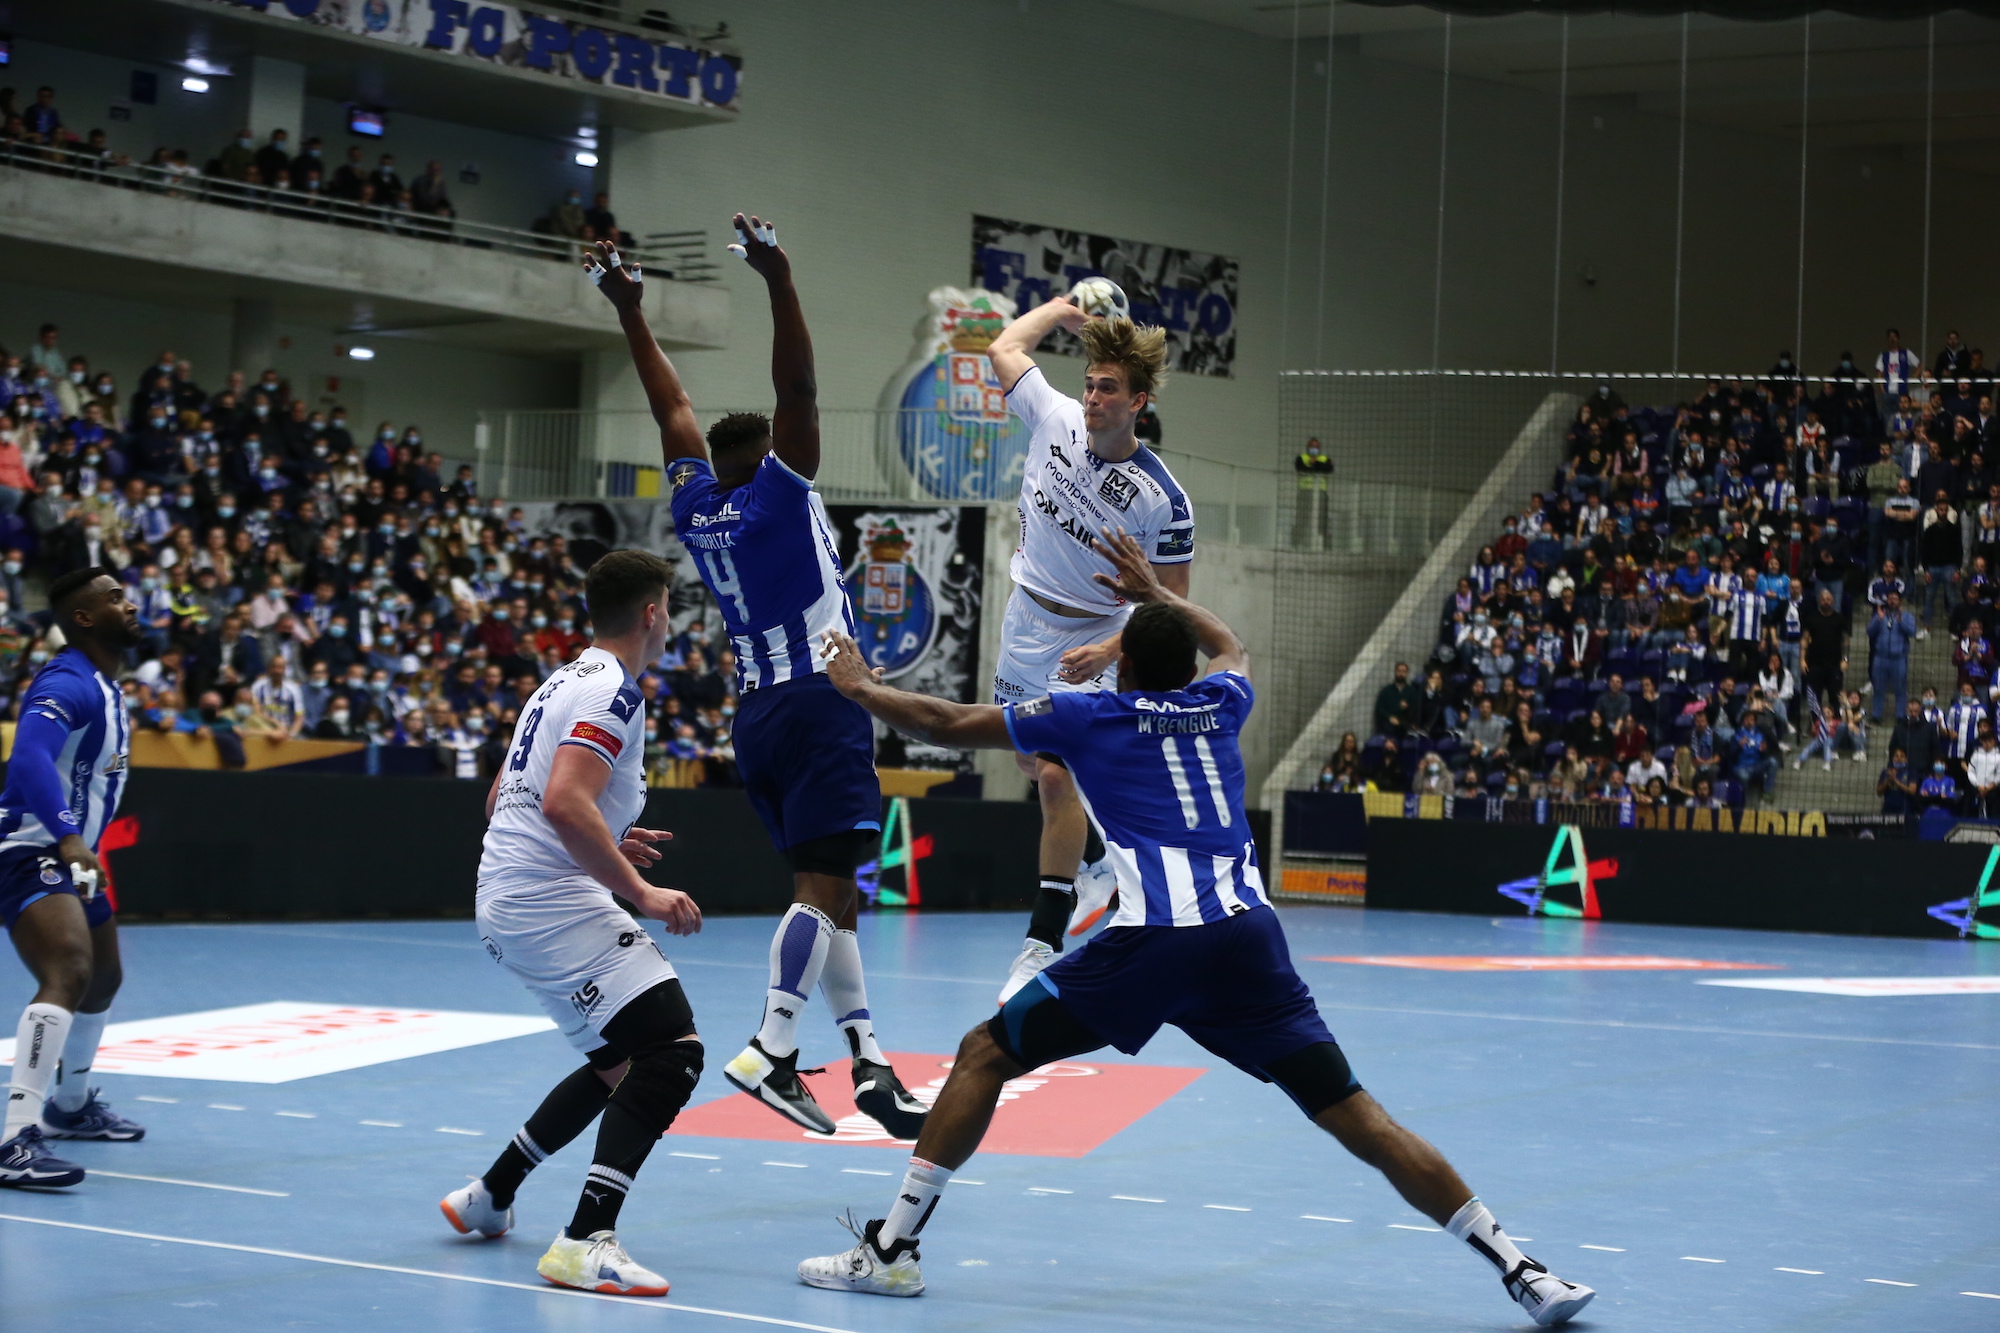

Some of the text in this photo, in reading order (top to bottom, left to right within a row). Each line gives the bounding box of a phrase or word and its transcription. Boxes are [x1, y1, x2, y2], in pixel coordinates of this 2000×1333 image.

[424, 0, 738, 105] FC PORTO
[1045, 461, 1108, 523] Montpellier
[1138, 473, 1161, 497] VEOLIA
[703, 549, 750, 624] 4
[1138, 711, 1220, 735] M'BENGUE
[1161, 735, 1232, 830] 11
